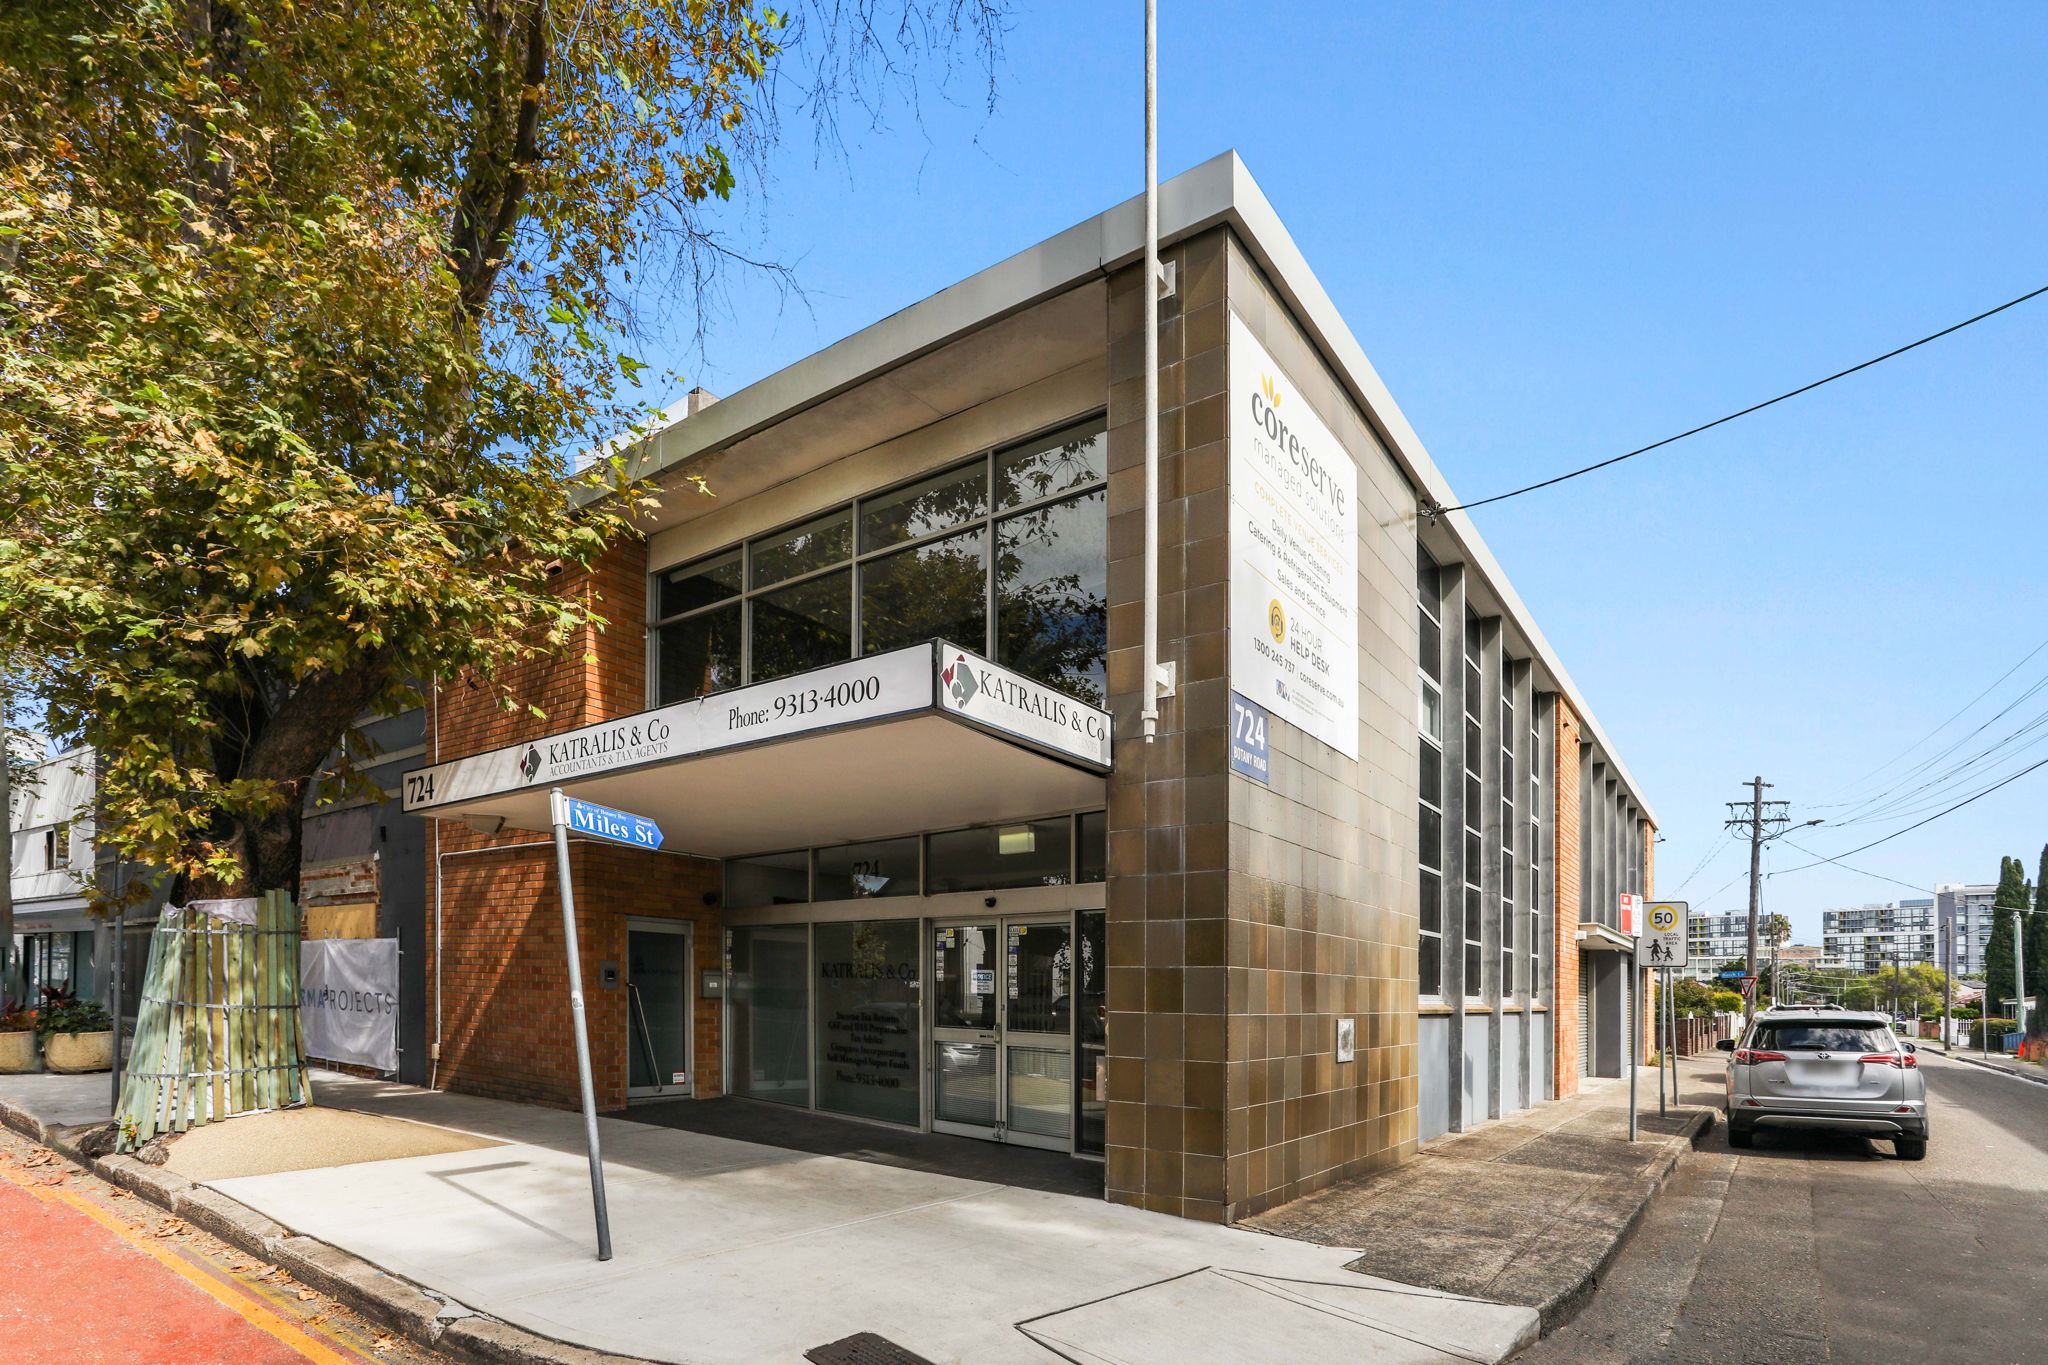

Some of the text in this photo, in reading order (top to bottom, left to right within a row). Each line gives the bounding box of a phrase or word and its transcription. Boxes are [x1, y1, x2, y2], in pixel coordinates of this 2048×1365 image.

[1251, 392, 1345, 516] coreserve
[1253, 437, 1345, 543] managed solutions
[1254, 482, 1292, 526] COMPLETE
[1293, 521, 1316, 546] VENUE
[1248, 521, 1276, 556] Catering
[1283, 552, 1320, 593] Refrigeration
[1272, 519, 1331, 584] Daily Venue Cleaning
[1277, 569, 1326, 619] Sales and Service
[1290, 617, 1323, 652] 24 HOUR
[1253, 637, 1270, 658] 1300
[1271, 650, 1283, 667] 245
[1284, 658, 1295, 675] 737
[1290, 637, 1330, 677] HELP DESK
[728, 706, 769, 730] Phone:
[979, 669, 1067, 726] KATRALIS
[1071, 710, 1082, 733] &
[1086, 716, 1105, 741] Co
[549, 718, 670, 764] KATRALIS & Co
[1234, 703, 1266, 751] 724
[549, 741, 668, 777] ACCOUNTANTS & TAX AGENTS
[1233, 745, 1267, 772] BOTANY ROAD
[407, 773, 434, 804] 724
[574, 808, 654, 845] Miles St
[1654, 912, 1673, 924] 50
[821, 962, 884, 979] KATRALIS
[886, 963, 895, 979] &
